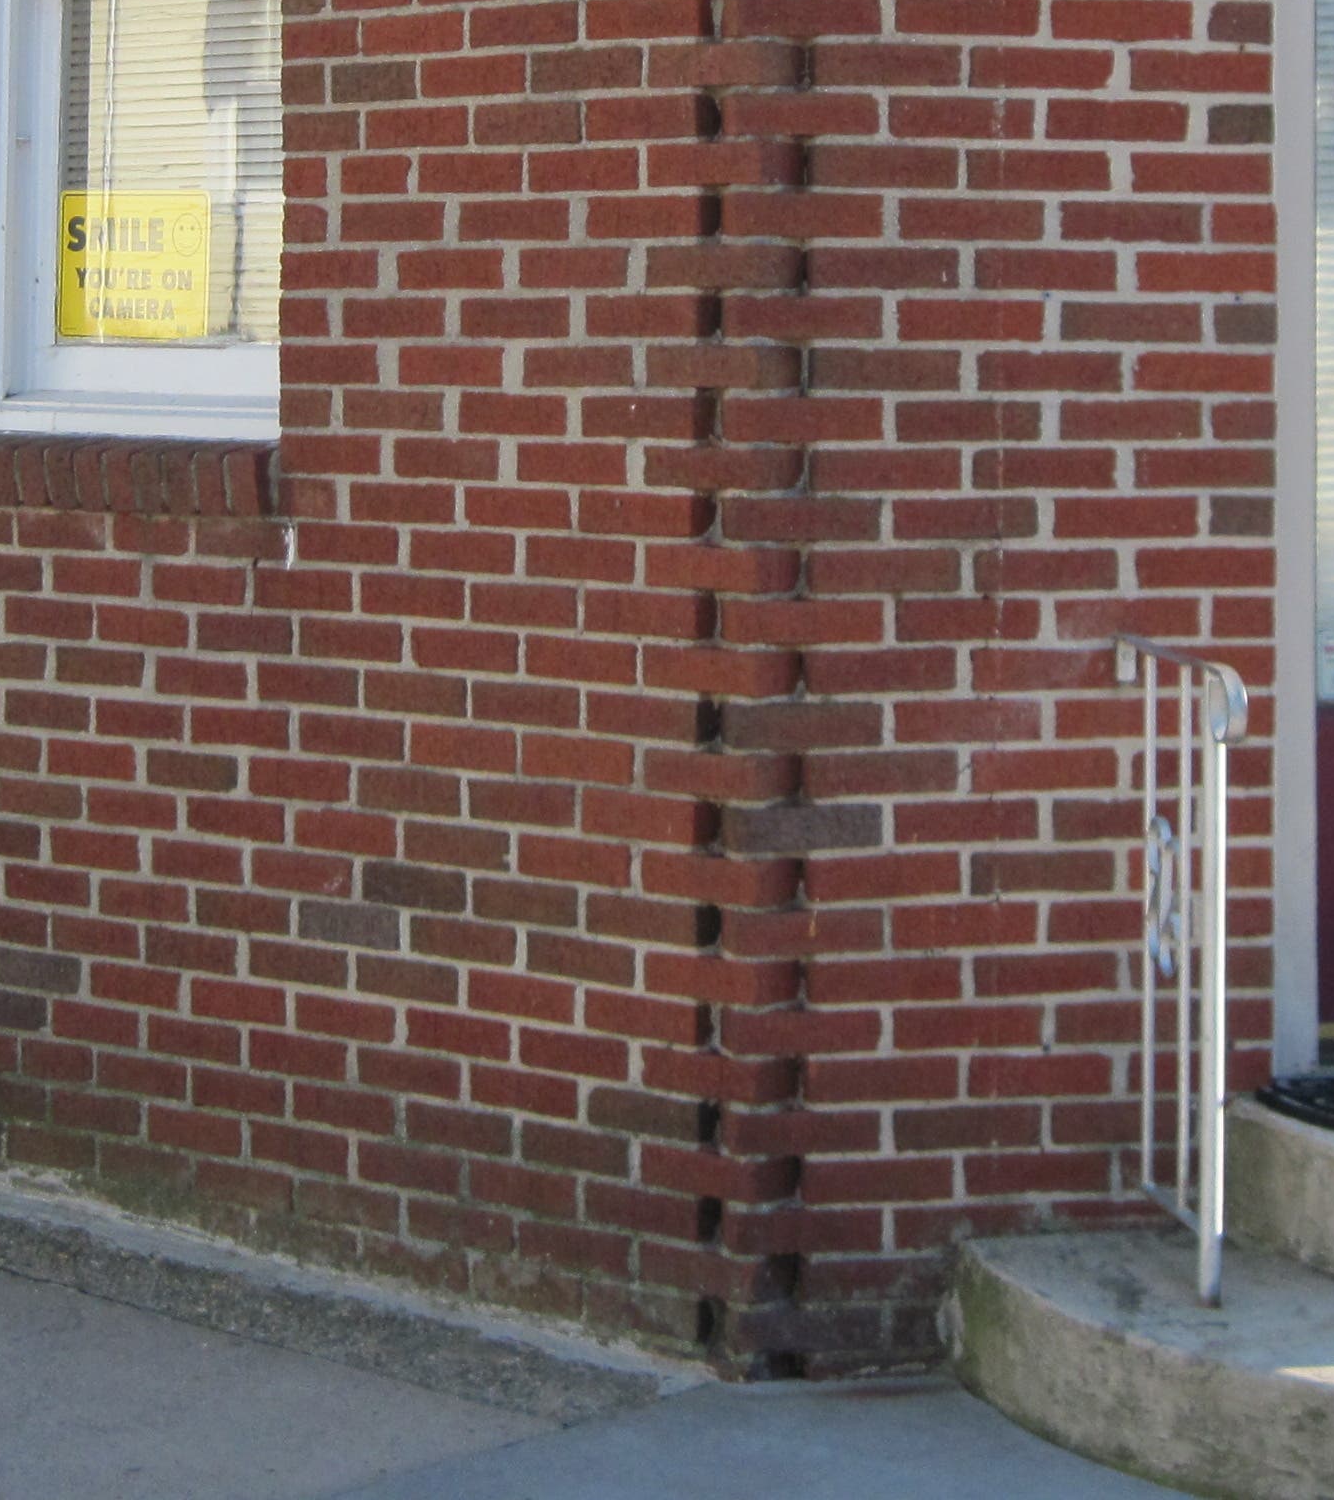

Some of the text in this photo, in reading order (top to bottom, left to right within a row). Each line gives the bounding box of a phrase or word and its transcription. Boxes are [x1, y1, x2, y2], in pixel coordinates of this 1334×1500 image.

[67, 215, 164, 253] SMILE
[75, 267, 193, 291] YOU'RE ON
[88, 298, 176, 321] CAMERA
